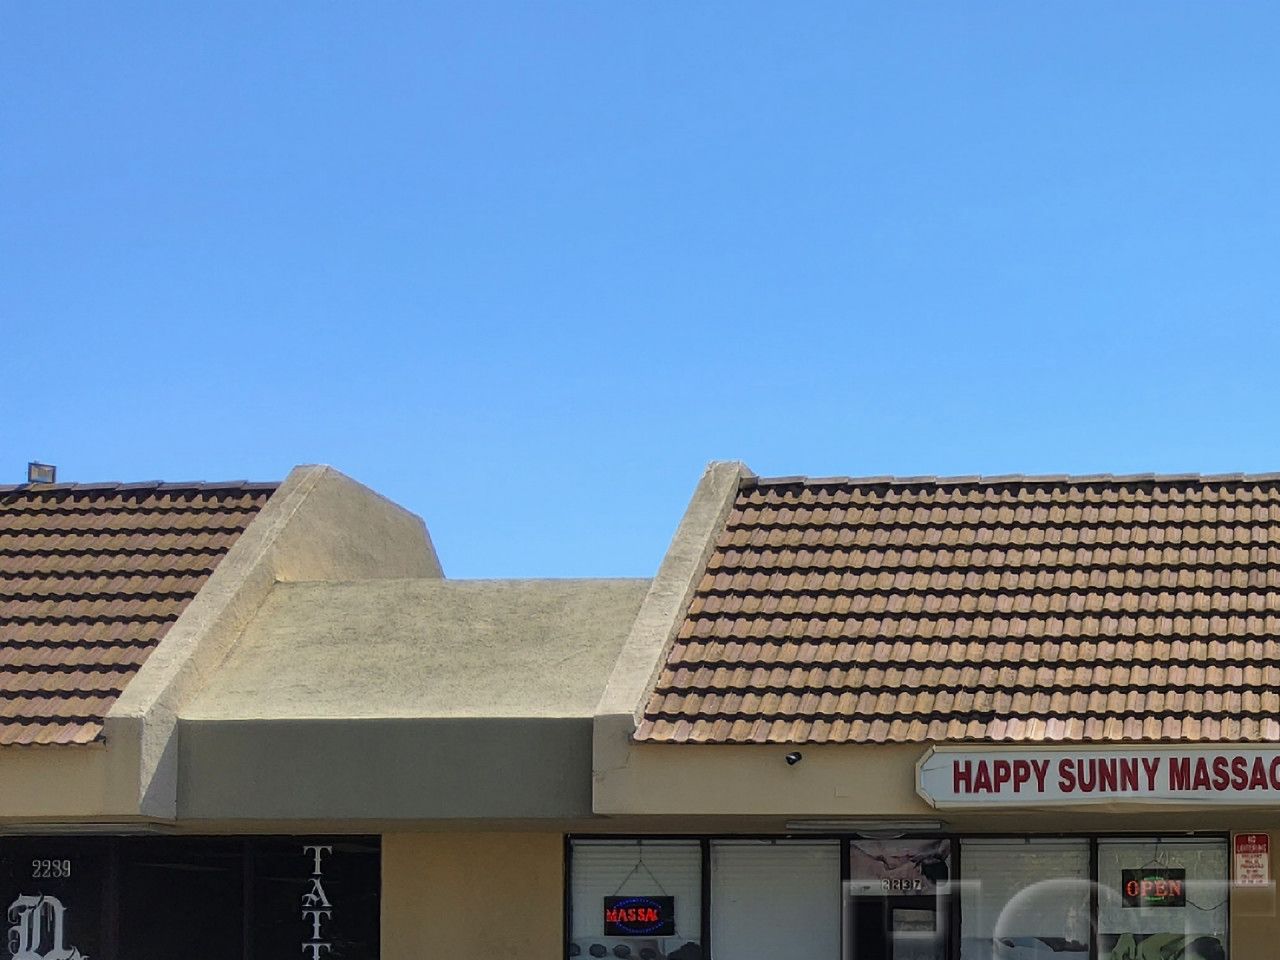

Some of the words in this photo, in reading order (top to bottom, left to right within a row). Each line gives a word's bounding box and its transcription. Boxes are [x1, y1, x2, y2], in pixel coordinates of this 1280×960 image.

[953, 758, 1050, 794] HAPPY
[1058, 757, 1161, 792] SUNNY
[881, 879, 922, 890] 2237
[1126, 880, 1183, 897] OPEN
